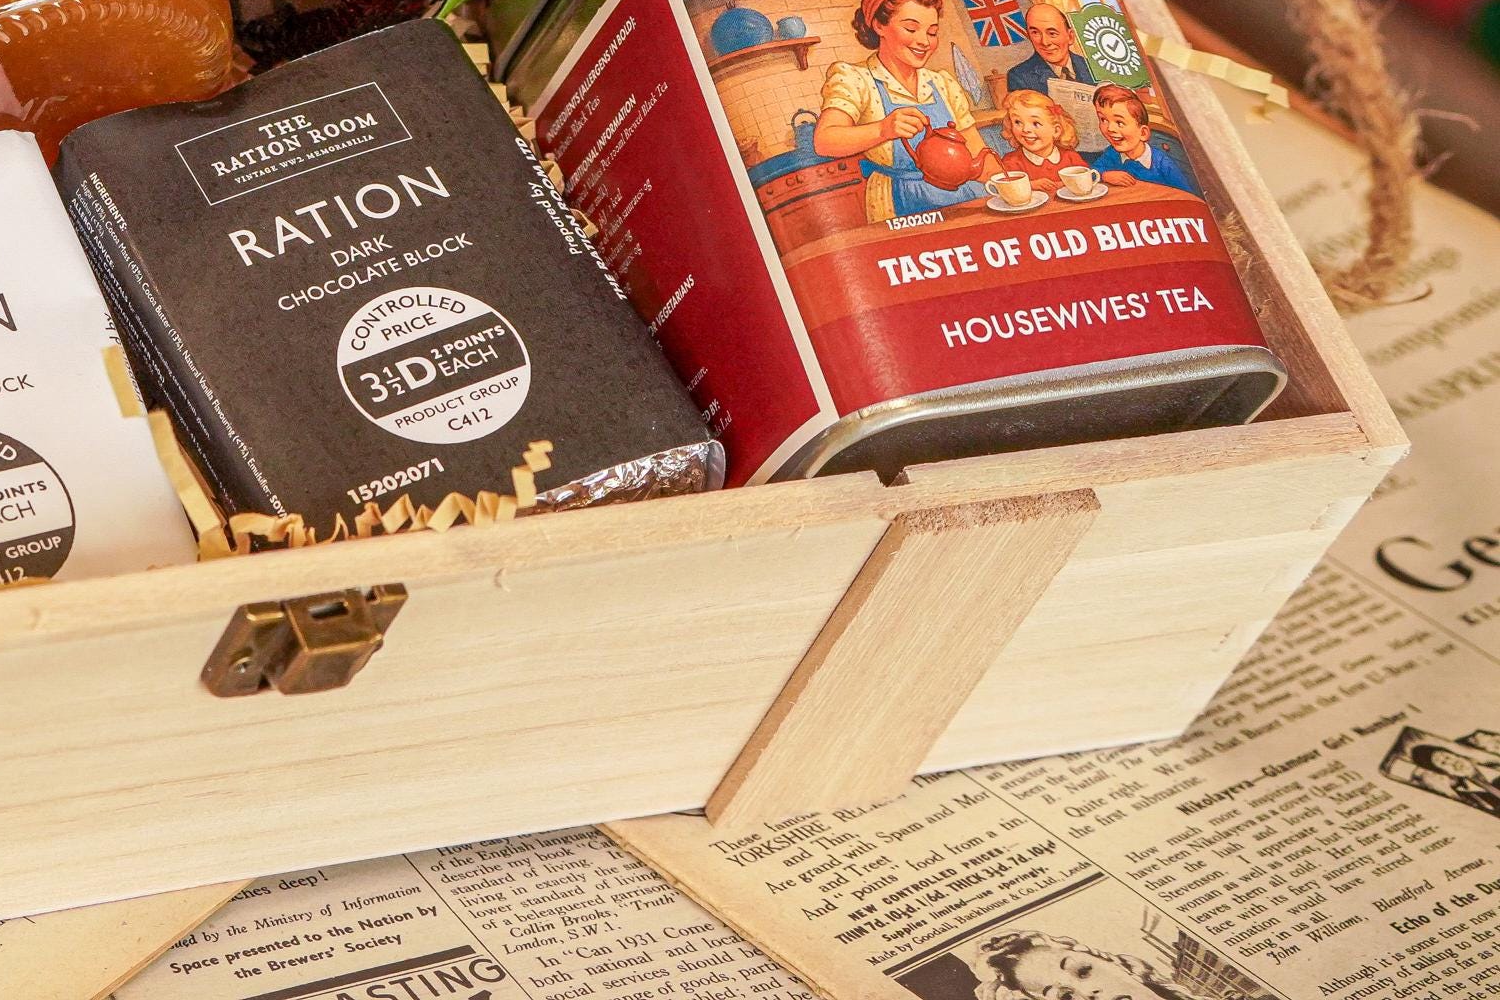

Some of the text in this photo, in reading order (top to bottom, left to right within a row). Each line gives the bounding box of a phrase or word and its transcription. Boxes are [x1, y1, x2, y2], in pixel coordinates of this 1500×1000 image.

[1083, 16, 1126, 48] AUTHENTIC
[1091, 50, 1133, 76] RECIPE
[211, 112, 379, 177] RATION ROOM
[258, 113, 312, 140] THE
[234, 133, 375, 185] VINTAGE WW2 MEMORABILIA
[89, 171, 128, 232] INGREDIENTS:
[228, 166, 451, 267] RATION
[514, 137, 628, 301] THE RATION ROOM LTD
[528, 181, 582, 256] Prepared by
[885, 210, 945, 231] 15202071
[277, 232, 474, 311] CHOCOLATE BLOCK
[330, 234, 393, 268] DARK
[876, 217, 1210, 288] TASTE OF OLD BLIGHTY
[104, 221, 120, 245] Cocoa
[118, 243, 131, 262] Mass
[141, 282, 157, 314] Cocoa
[155, 304, 171, 331] Butter
[181, 349, 201, 380] Natural
[198, 376, 214, 402] Vanilla
[211, 399, 236, 439] Flavouring
[351, 293, 467, 351] CONTROLLED
[380, 312, 437, 342] PRICE
[430, 324, 506, 360] 2 POINTS
[940, 285, 1215, 349] HOUSEWIVES' TEA
[437, 345, 499, 378] EACH
[394, 376, 520, 429] PRODUCT GROUP
[447, 407, 493, 432] C412
[346, 457, 445, 505] 15202071
[5, 535, 63, 560] GROUP
[724, 820, 833, 868] YORKSHIRE
[202, 884, 422, 945] by the Ministry of Information
[847, 868, 958, 922] NEW CONTROLLED
[1305, 913, 1370, 944] Williams,
[1372, 878, 1435, 914] Blandford
[1389, 888, 1479, 936] Echo of the
[169, 904, 438, 976] Space presented to the Nation by
[509, 909, 619, 939] Collin Brooks,
[233, 933, 403, 980] the Brewers' Society
